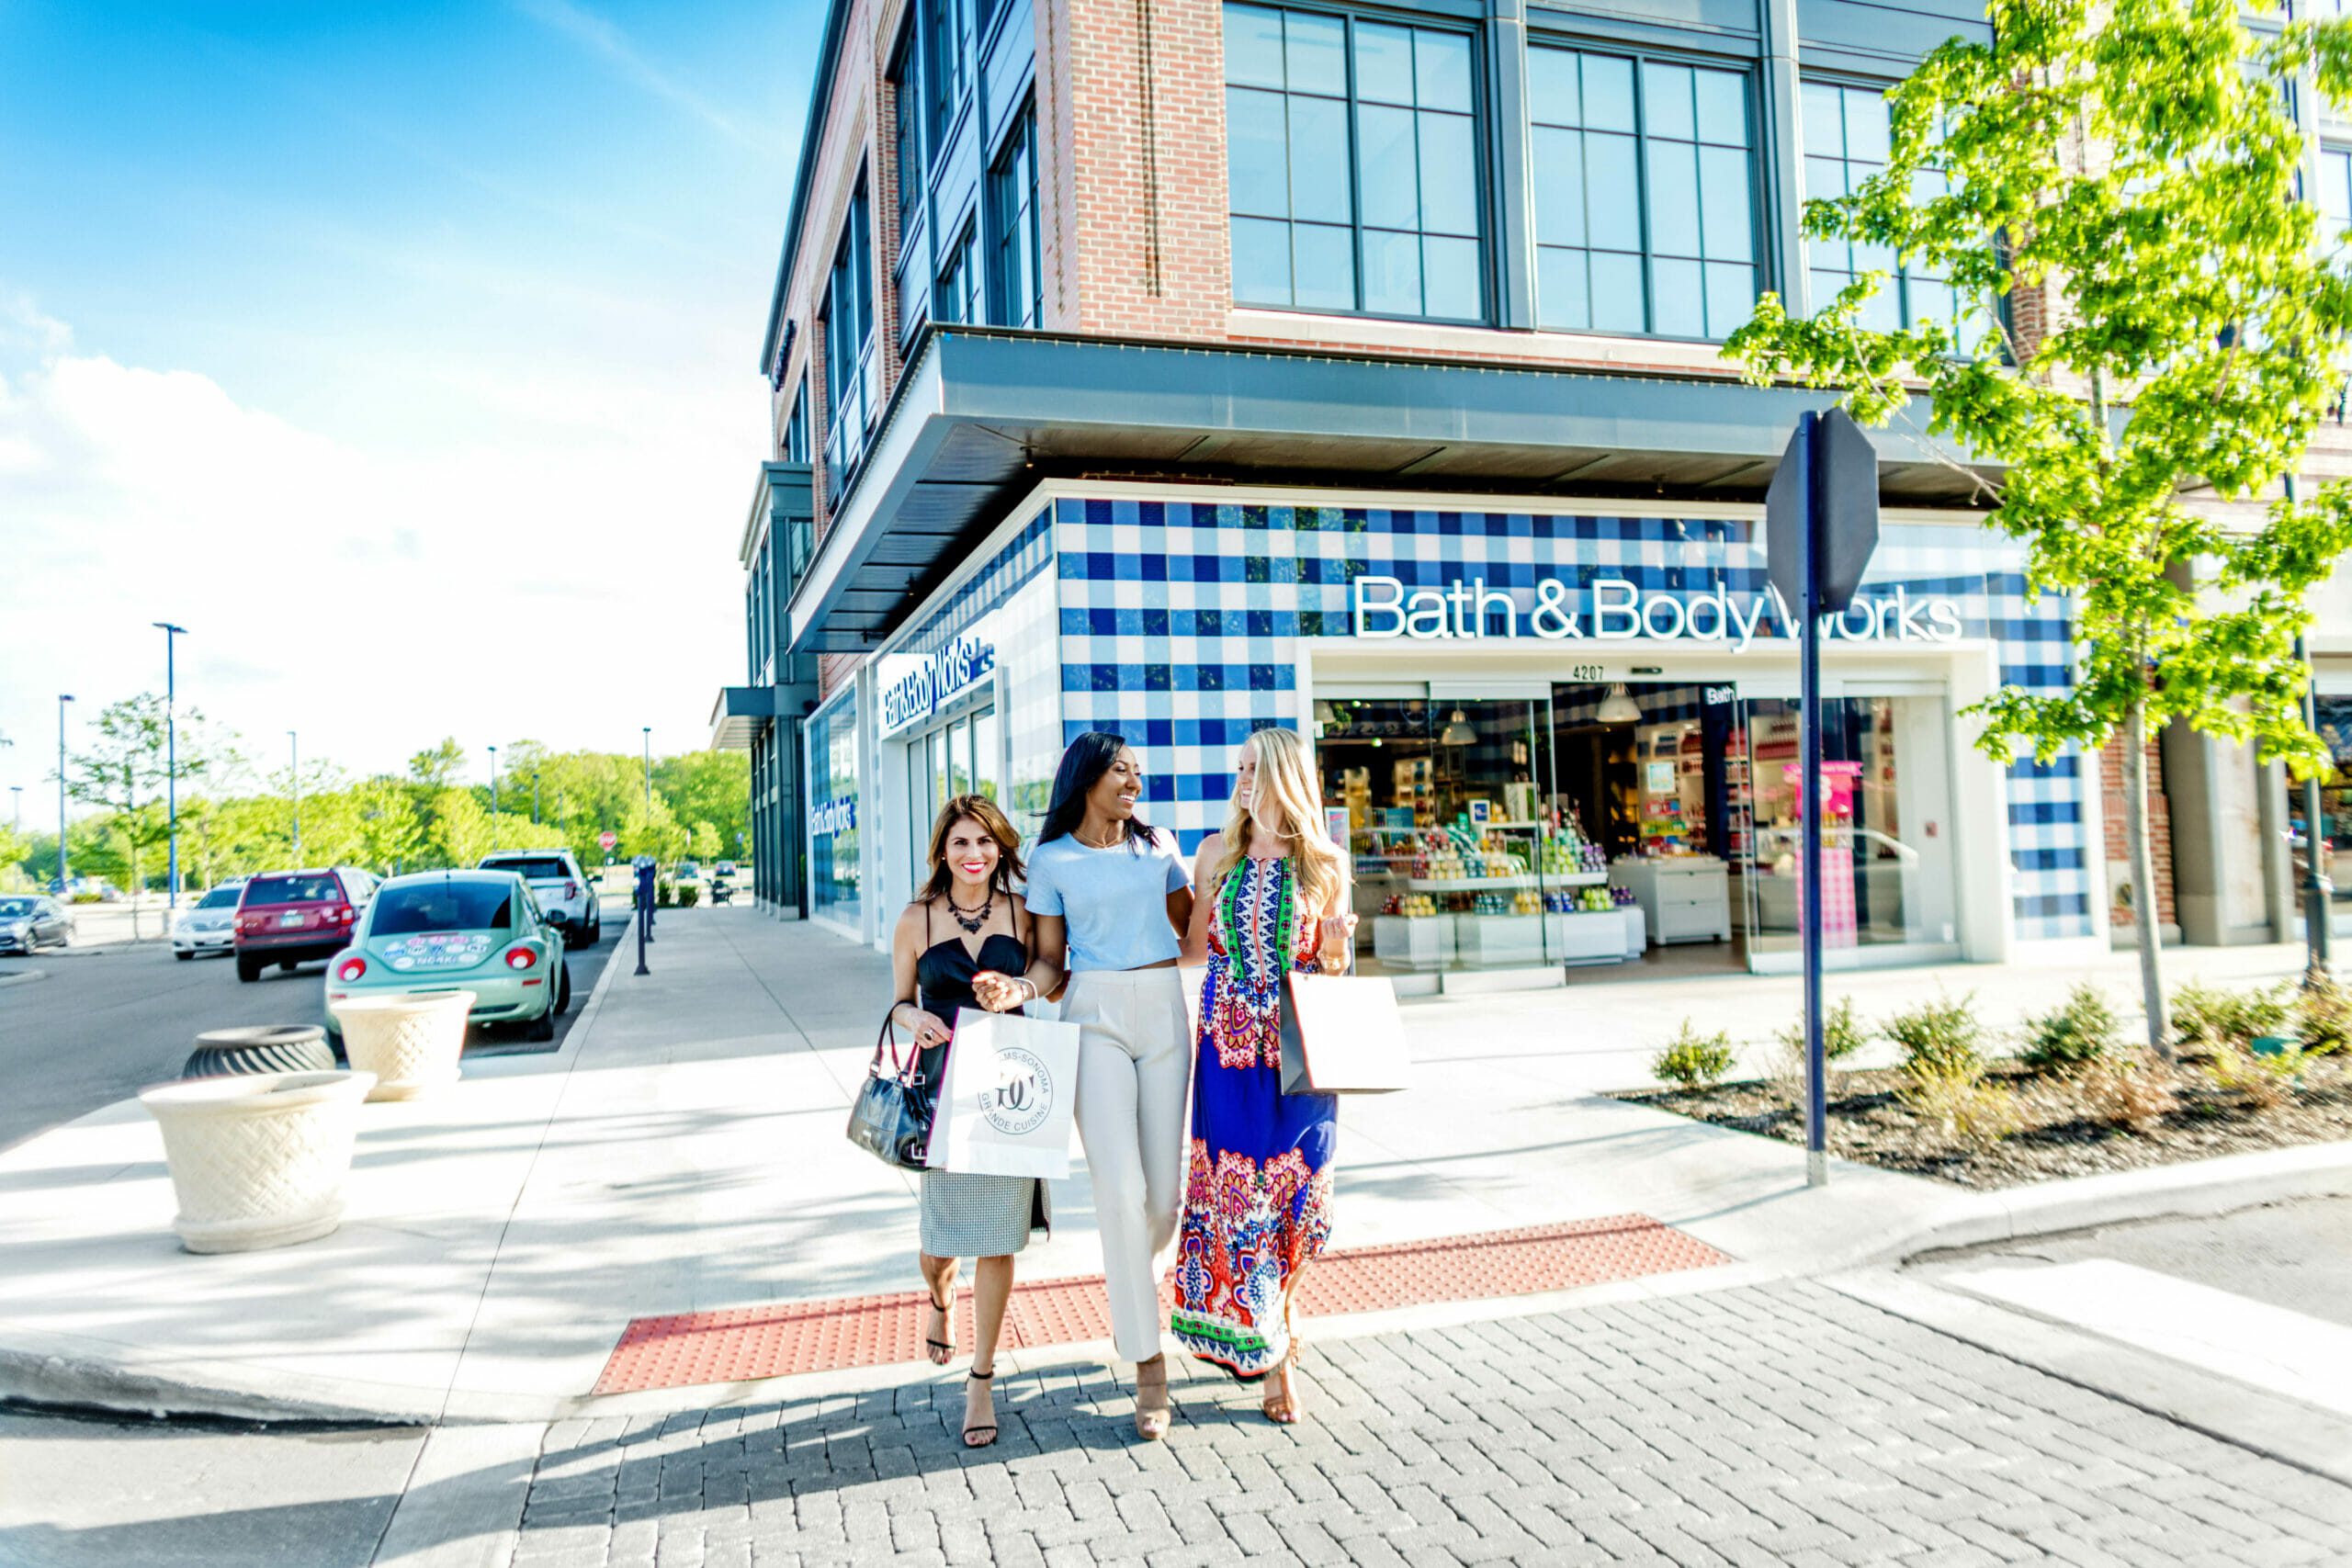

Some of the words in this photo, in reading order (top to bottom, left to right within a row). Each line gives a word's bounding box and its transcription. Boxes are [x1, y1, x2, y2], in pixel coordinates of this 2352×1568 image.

[1354, 575, 1516, 639] Bath
[1532, 578, 1584, 640] &
[1592, 579, 1765, 653] Body
[935, 636, 973, 700] Works
[1573, 665, 1604, 680] 4207
[1705, 685, 1736, 705] Bath
[1013, 1102, 1048, 1132] CUISINE
